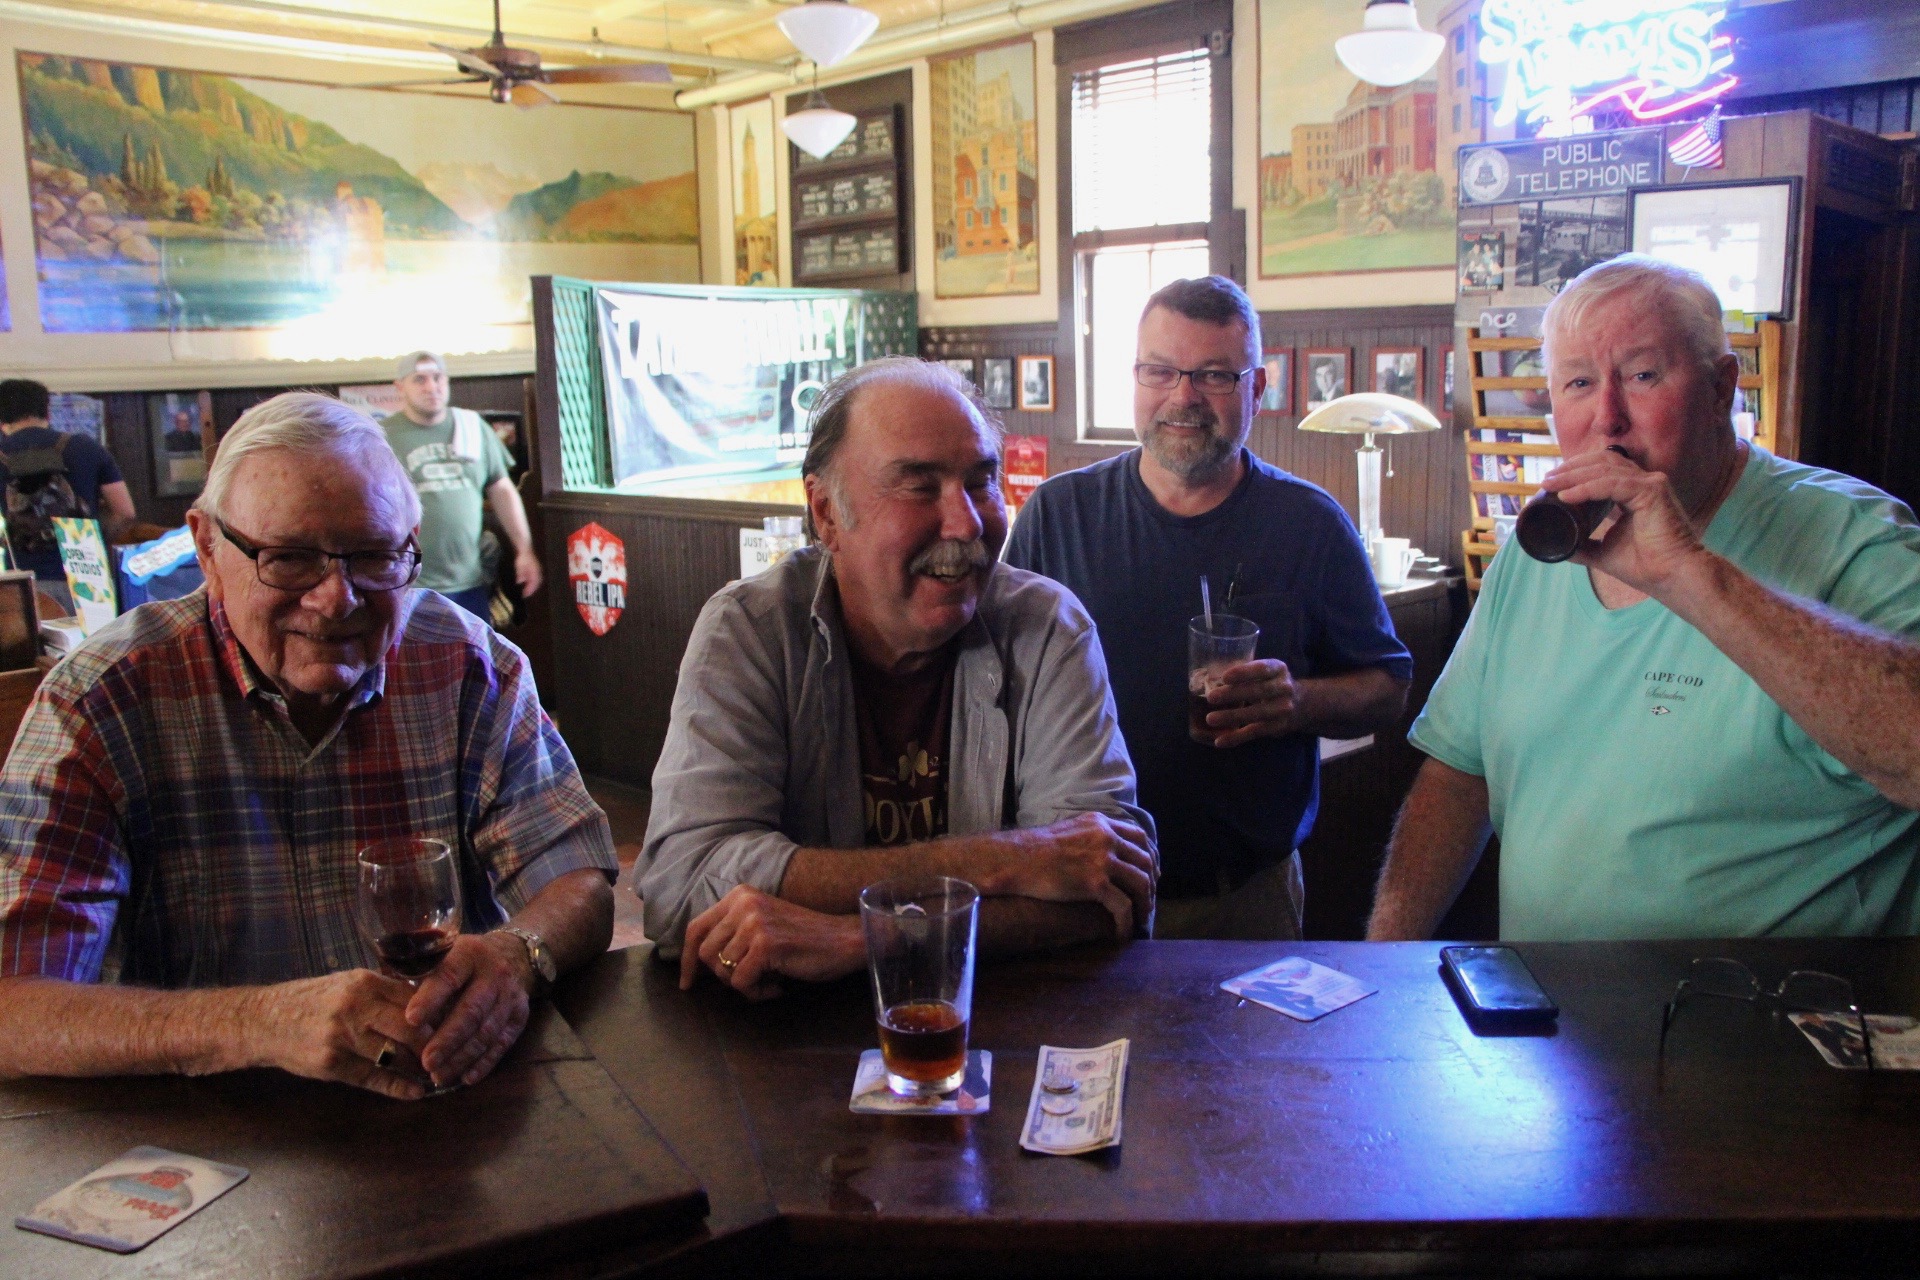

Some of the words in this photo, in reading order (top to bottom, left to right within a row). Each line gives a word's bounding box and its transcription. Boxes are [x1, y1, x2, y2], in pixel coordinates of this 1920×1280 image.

[1543, 140, 1622, 167] PUBLIC
[1516, 162, 1650, 194] TELEPHONE
[743, 536, 762, 548] JUST
[66, 548, 86, 561] OPEN
[70, 562, 102, 576] STUDIOS
[576, 580, 608, 608] REBEL
[607, 583, 626, 609] IPA
[1644, 671, 1676, 683] CAPE
[1677, 675, 1703, 687] COD
